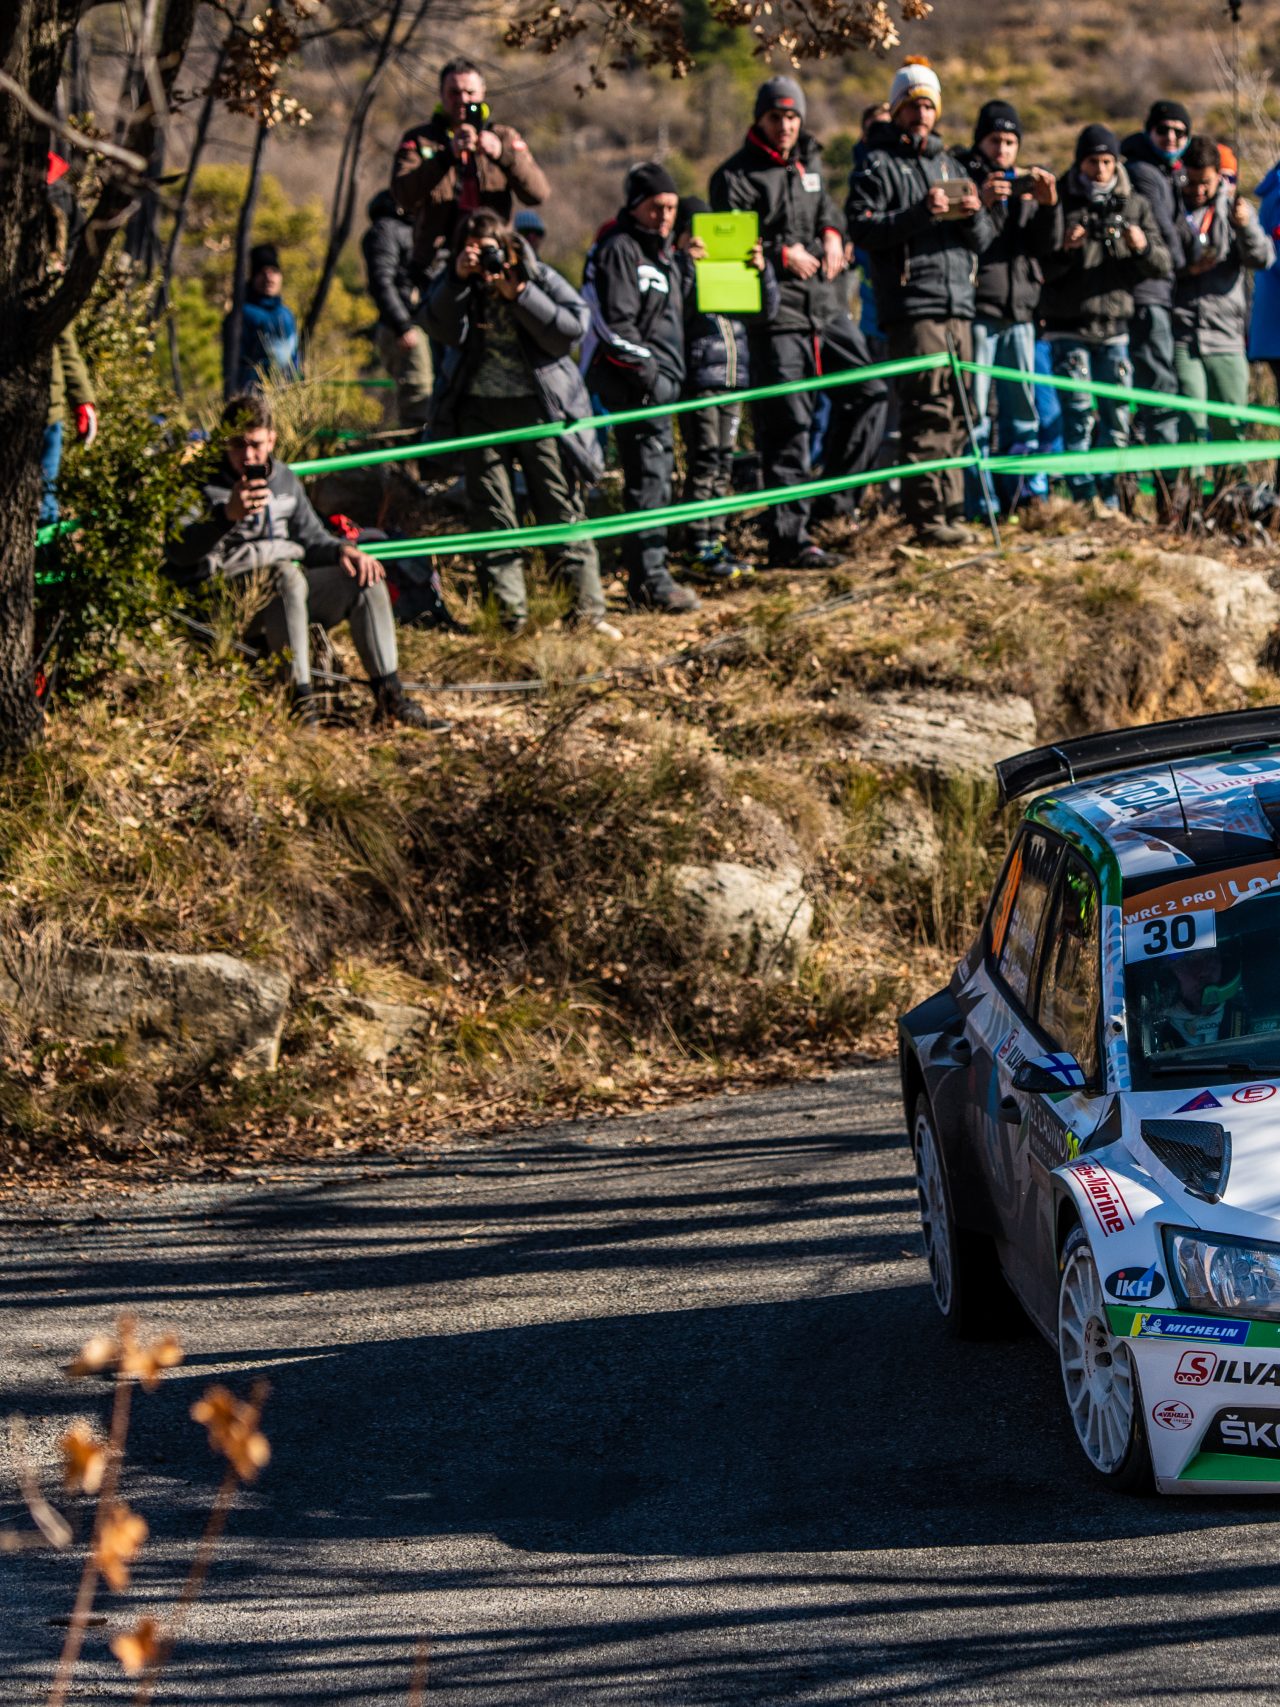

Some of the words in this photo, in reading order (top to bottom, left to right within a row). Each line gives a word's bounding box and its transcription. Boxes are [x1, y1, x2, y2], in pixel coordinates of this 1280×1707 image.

[1124, 903, 1162, 925] WRC
[1166, 901, 1177, 912] 2
[1182, 890, 1217, 907] PRO
[1142, 914, 1197, 955] 30
[1243, 1087, 1265, 1100] E
[1165, 1322, 1239, 1338] MICHELIN
